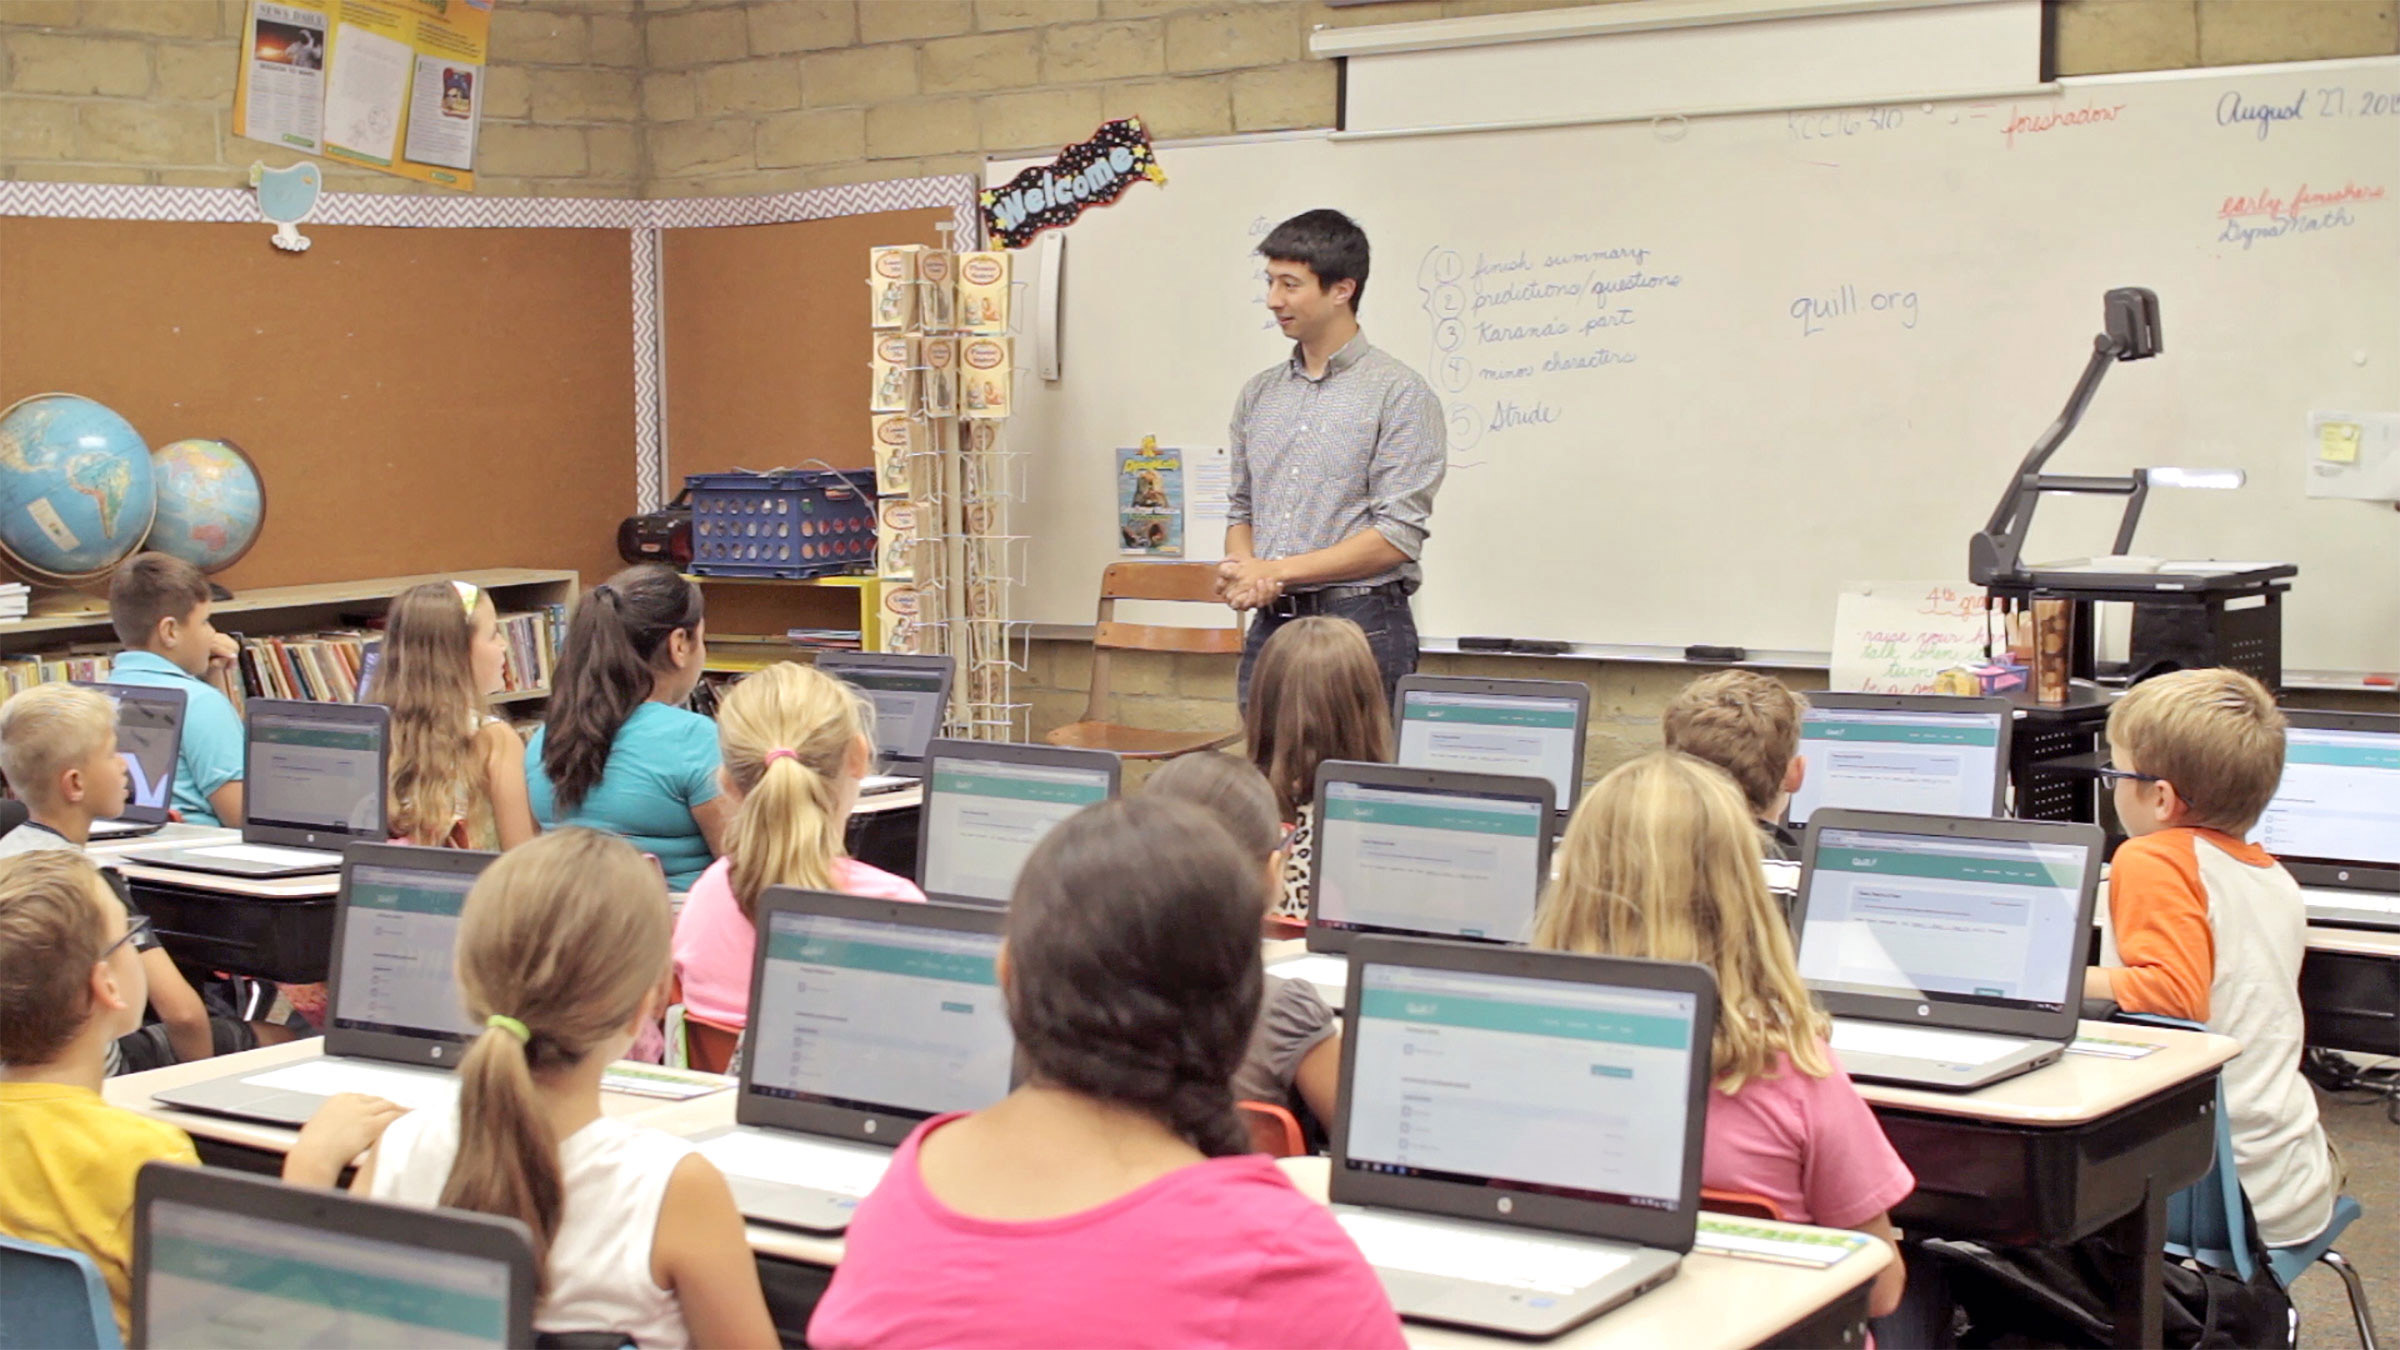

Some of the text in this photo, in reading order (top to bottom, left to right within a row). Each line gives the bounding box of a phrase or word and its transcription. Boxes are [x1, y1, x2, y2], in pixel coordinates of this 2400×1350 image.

[2000, 101, 2126, 149] foreshadow
[2217, 89, 2307, 142] August
[992, 146, 1134, 231] Welcome
[2219, 181, 2387, 220] early finishers
[1470, 252, 1533, 292] finish
[1543, 247, 1652, 266] summary
[1578, 309, 1637, 337] part
[1790, 284, 1918, 337] quill.org
[1479, 360, 1534, 381] minor
[1542, 349, 1637, 372] characters
[1487, 401, 1562, 433] Stride
[1926, 587, 1956, 607] 4th
[1917, 629, 1966, 655] your
